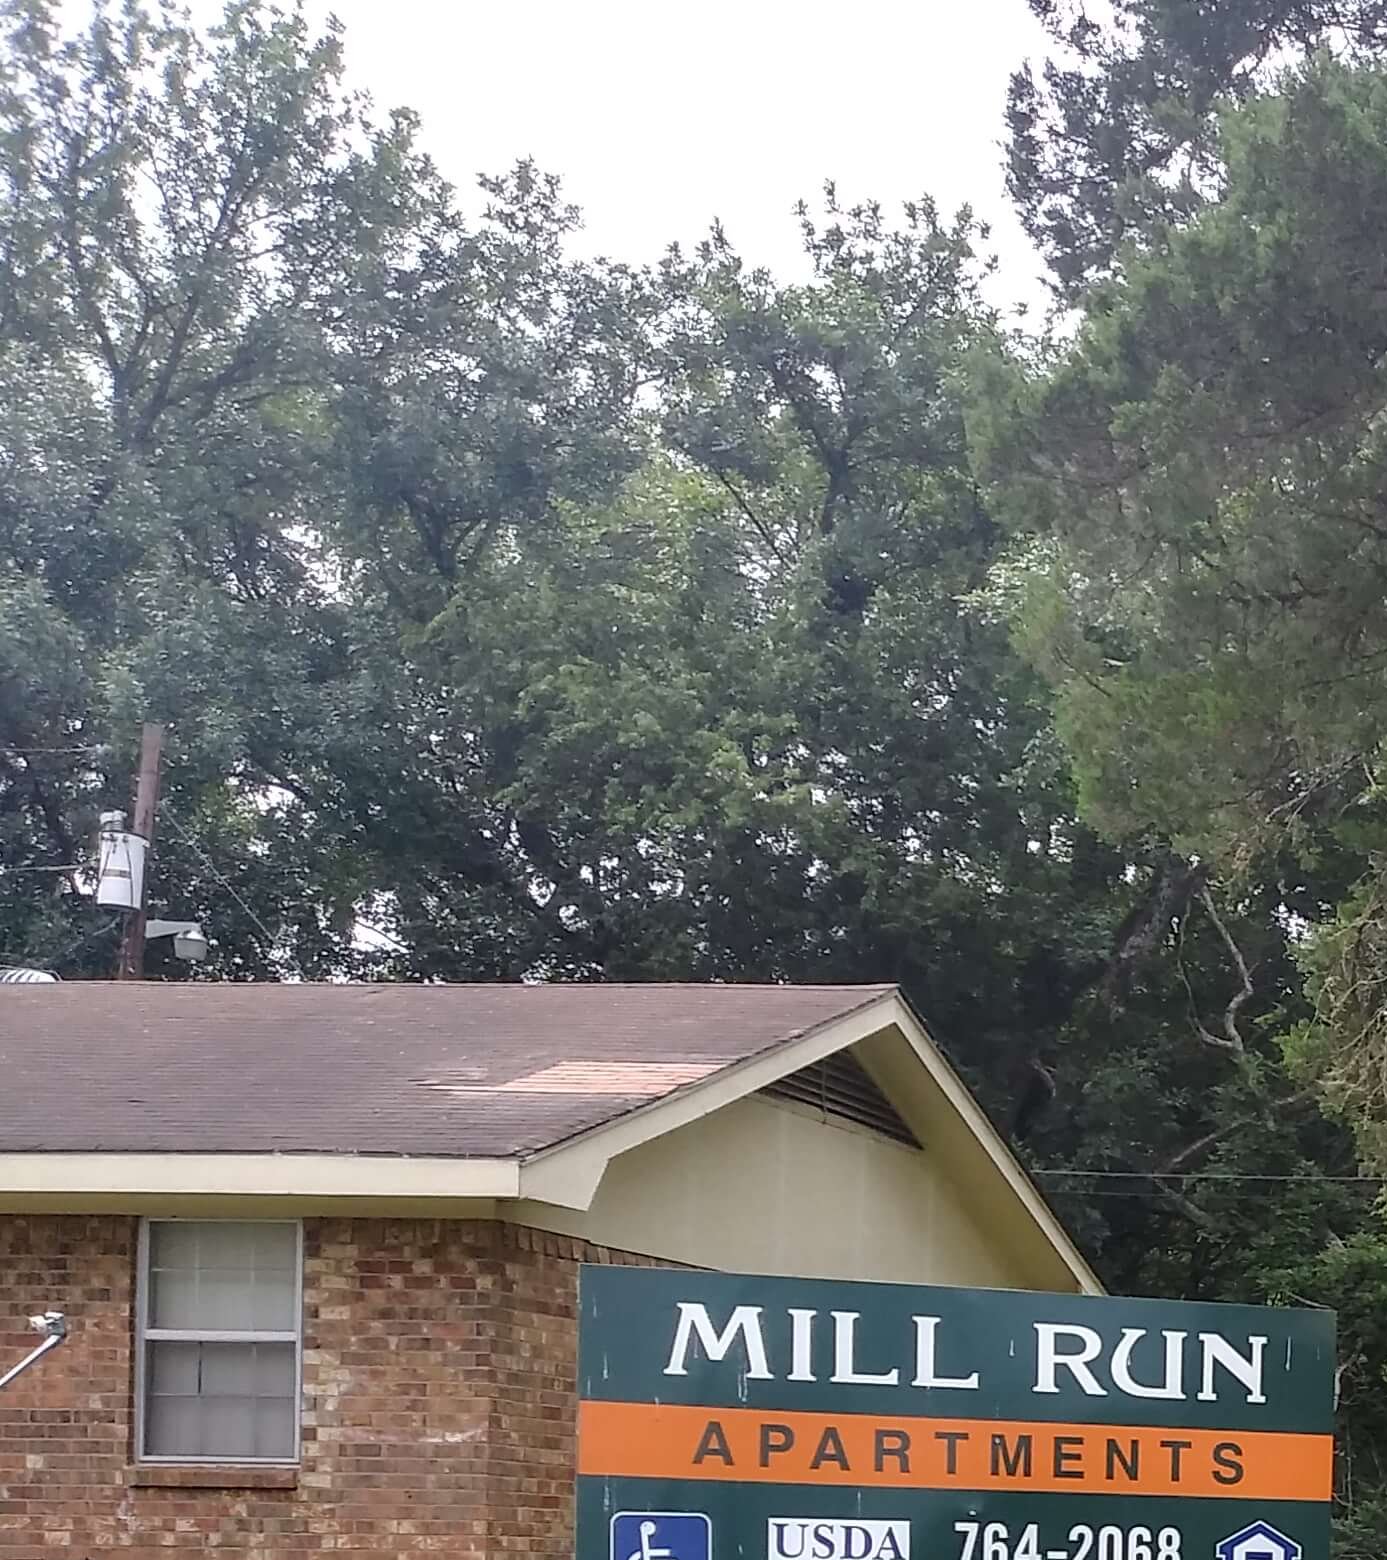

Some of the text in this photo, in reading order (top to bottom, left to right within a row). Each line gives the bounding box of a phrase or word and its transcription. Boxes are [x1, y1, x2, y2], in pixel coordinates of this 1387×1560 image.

[663, 1301, 1270, 1403] MILL RUN
[692, 1421, 1246, 1486] APARTMENTS
[771, 1523, 906, 1560] USDA
